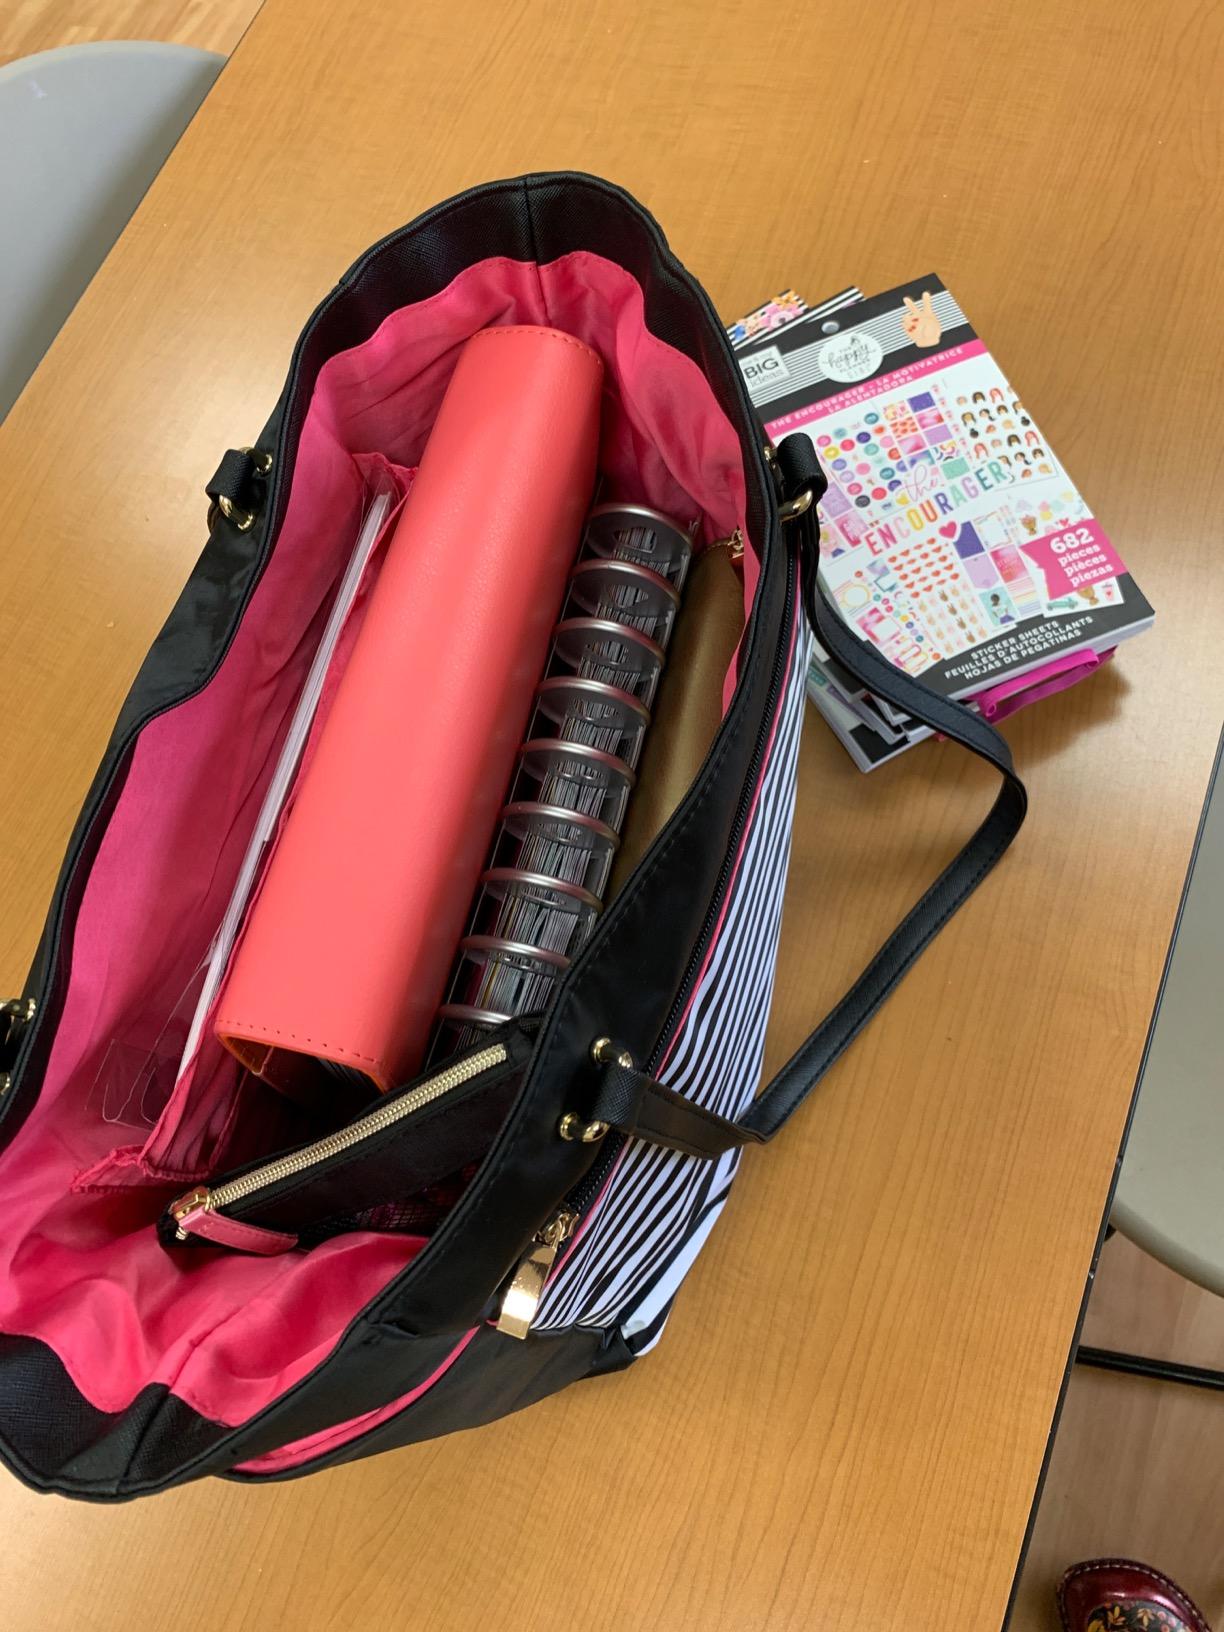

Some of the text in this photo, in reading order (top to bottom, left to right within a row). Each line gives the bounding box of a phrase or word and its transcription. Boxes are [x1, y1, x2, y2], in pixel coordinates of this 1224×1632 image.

[743, 358, 779, 379] BIG
[771, 417, 792, 429] THE
[794, 386, 864, 419] ENCOURAGER
[892, 348, 963, 379] MOTIVATRICE
[844, 375, 913, 407] ALENTADORA
[865, 461, 1007, 556] ENCOURAGER
[1050, 527, 1094, 554] 682
[1057, 543, 1101, 567] pieces
[1063, 552, 1108, 577] pièces
[1070, 564, 1114, 588] piezas
[944, 616, 1093, 679] FEUILLES D'AUTOCOLLANTS
[964, 629, 1081, 680] HOJAS DE PEGATINAS
[971, 620, 1059, 660] STICKER SHEETS
